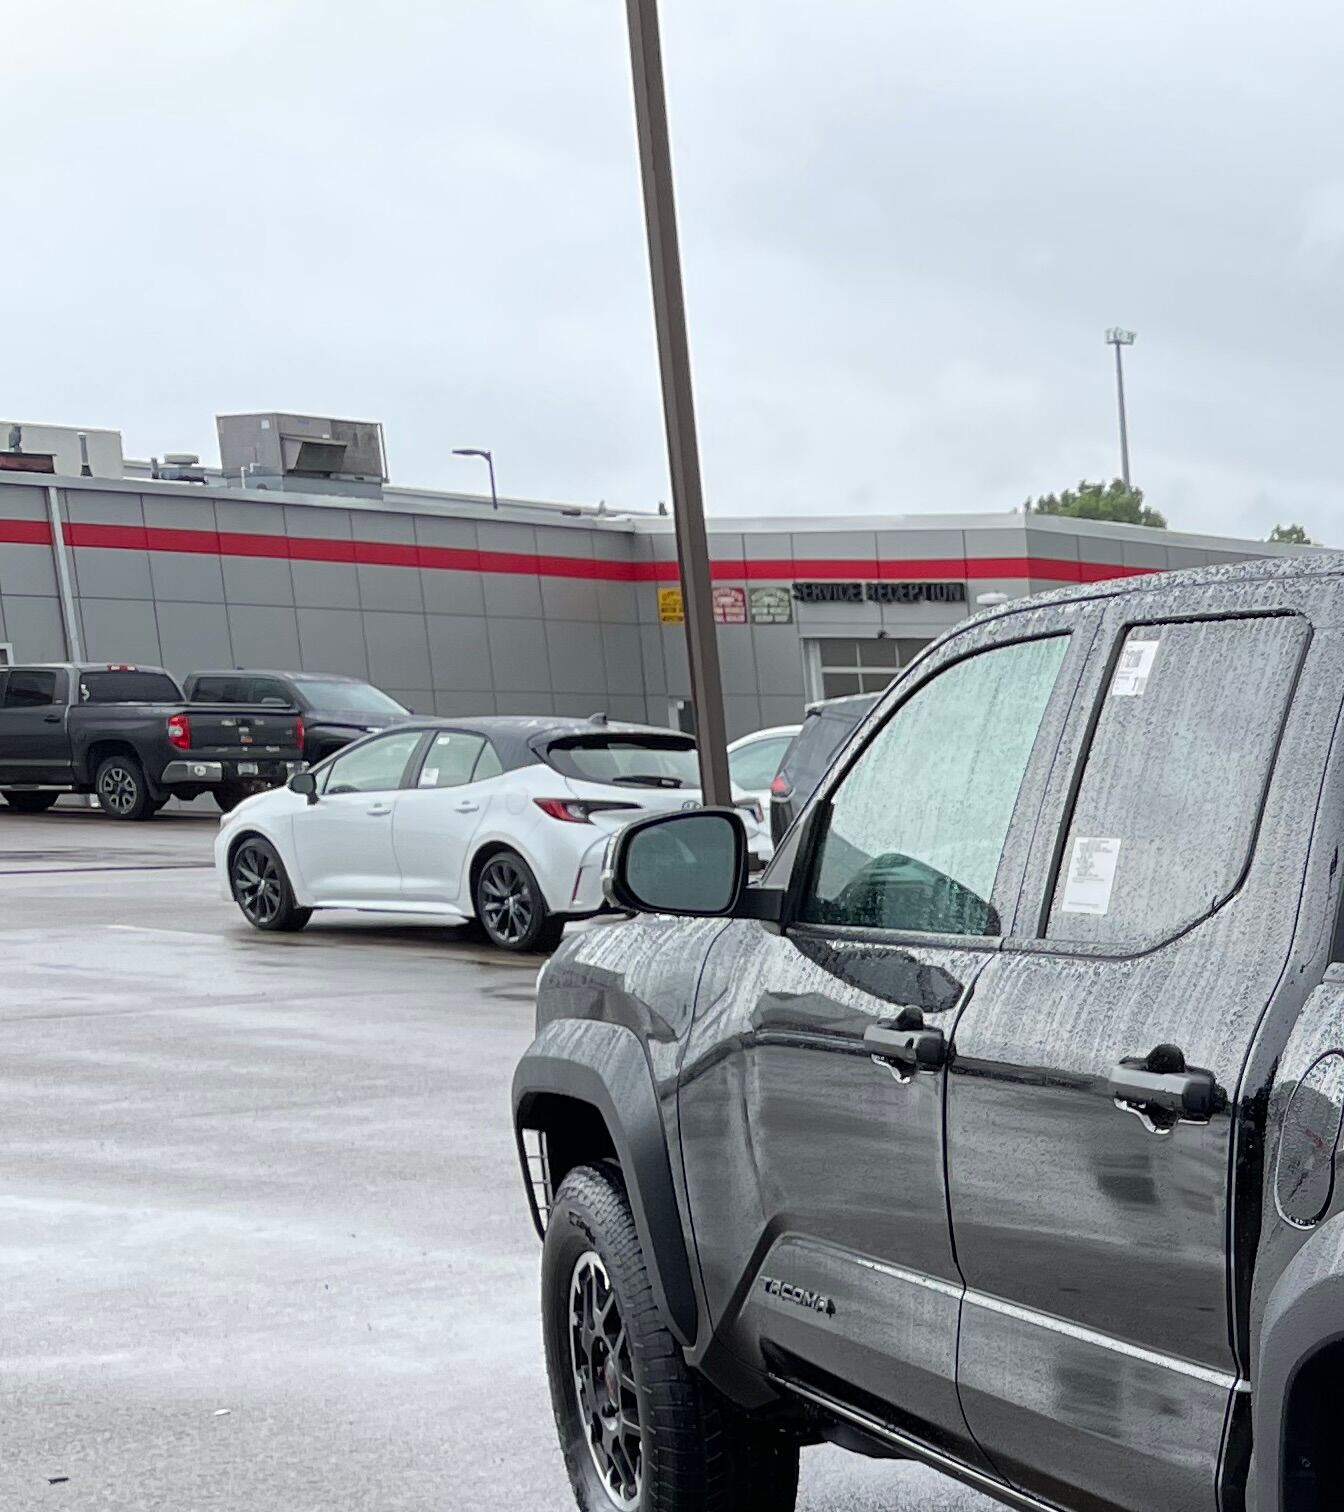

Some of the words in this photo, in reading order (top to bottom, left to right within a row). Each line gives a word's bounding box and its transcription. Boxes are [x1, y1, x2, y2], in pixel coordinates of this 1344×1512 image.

[792, 582, 862, 602] SERVICE
[866, 582, 965, 603] RECEPTION
[760, 1275, 835, 1315] TACOMA
